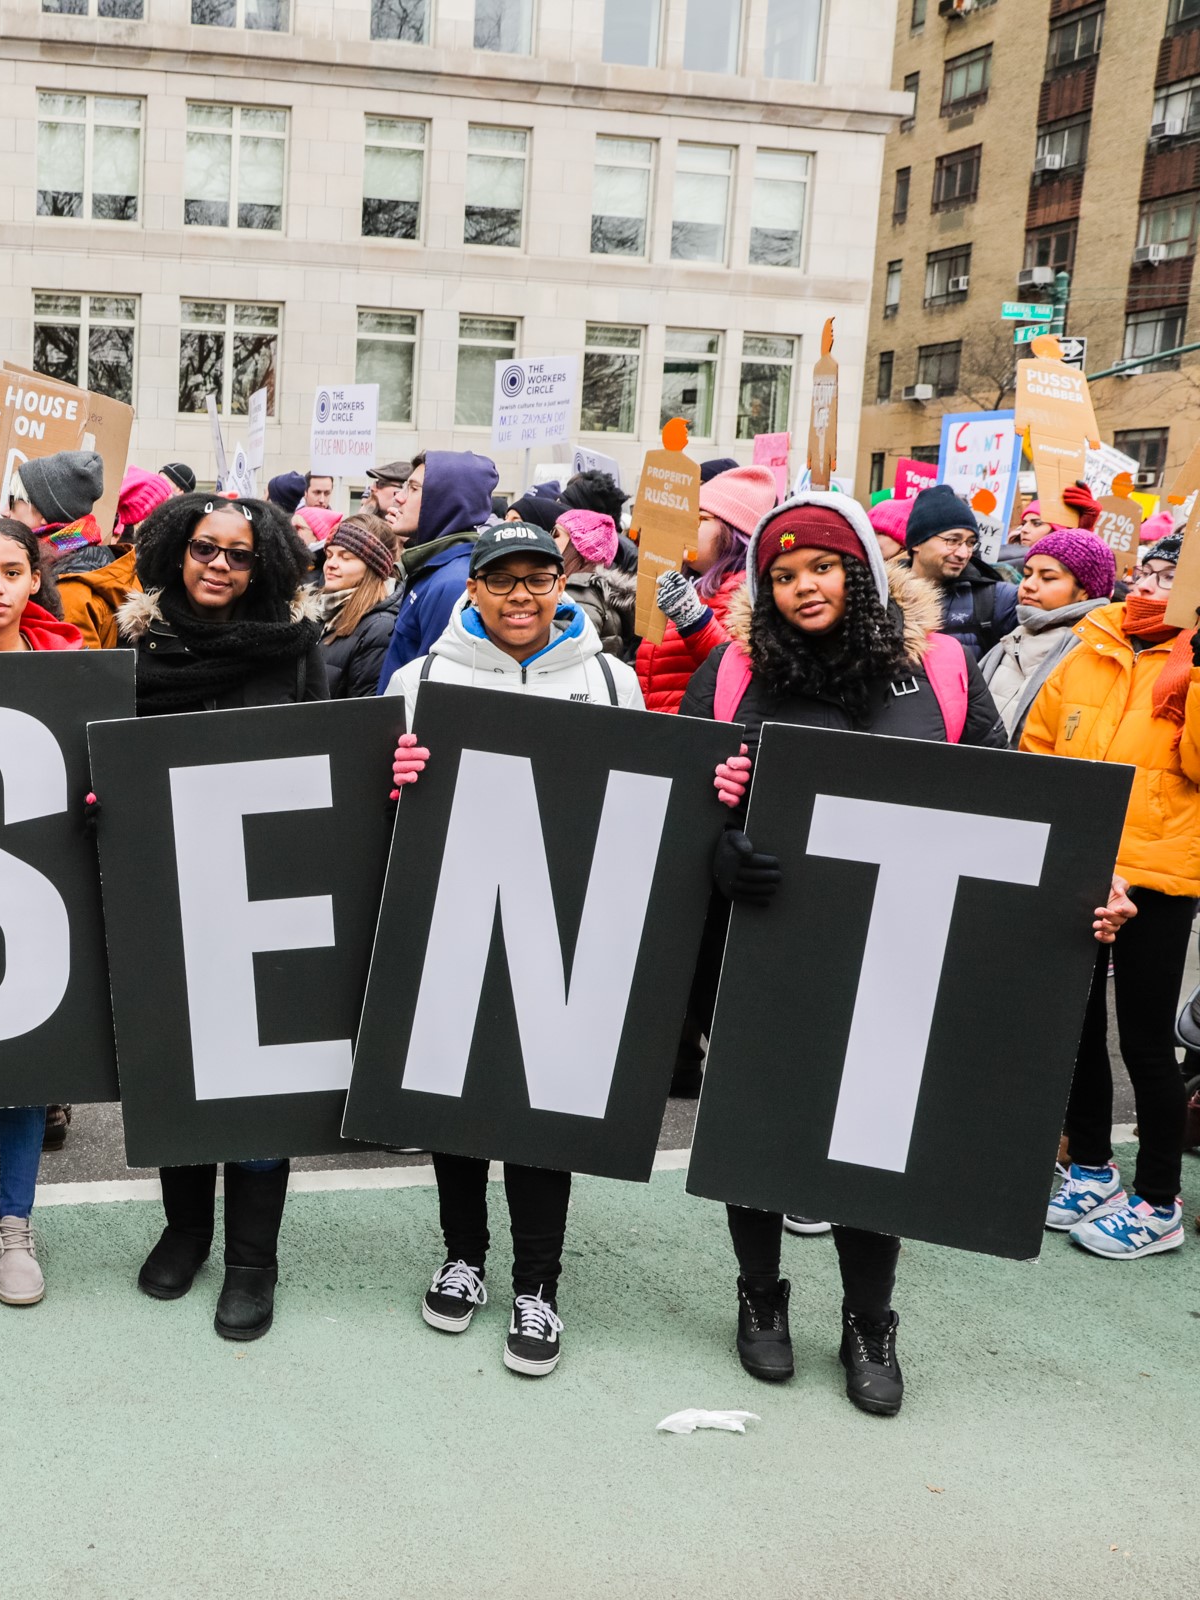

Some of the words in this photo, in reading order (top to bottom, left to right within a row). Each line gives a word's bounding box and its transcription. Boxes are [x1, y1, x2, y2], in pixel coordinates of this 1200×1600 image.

[1004, 304, 1030, 314] CENTRAL
[529, 364, 545, 374] THE
[528, 373, 567, 385] WORKERS
[1026, 368, 1083, 392] PUSSY
[332, 391, 344, 400] THE
[526, 385, 554, 395] CIRCLE
[1026, 383, 1084, 404] GRABBER
[5, 385, 78, 421] HOUSE
[331, 401, 365, 411] WORKERS
[331, 412, 353, 422] CIRCLE
[14, 415, 46, 440] ON
[499, 431, 512, 442] WE
[521, 428, 537, 440] ARE
[586, 456, 596, 467] THE
[647, 466, 693, 486] PROPERTY
[906, 470, 937, 489] Toge
[663, 482, 673, 490] OF
[644, 487, 689, 512] RUSSIA
[1097, 511, 1135, 535] 72%
[569, 693, 590, 702] NIKE
